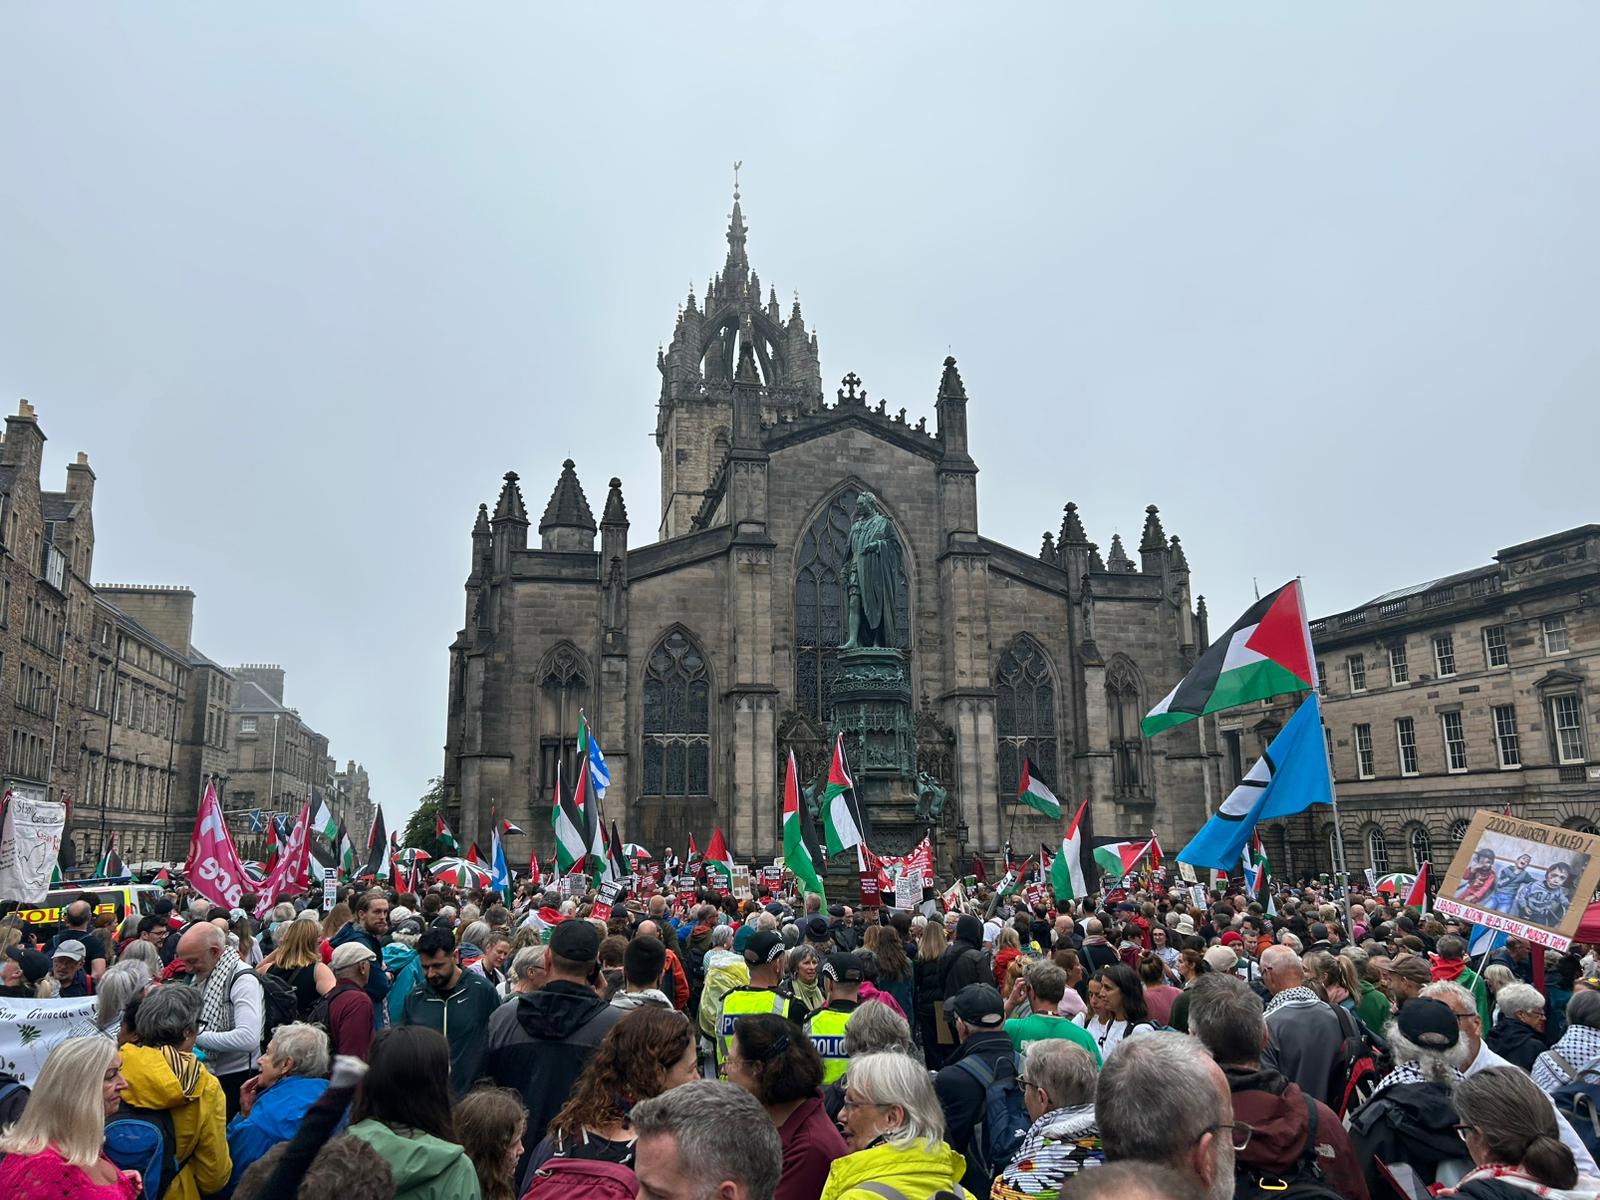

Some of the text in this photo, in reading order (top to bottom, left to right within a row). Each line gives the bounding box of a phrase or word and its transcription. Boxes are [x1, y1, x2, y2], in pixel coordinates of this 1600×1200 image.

[1552, 832, 1584, 849] KILLED
[9, 903, 114, 923] POLE
[1463, 907, 1483, 922] ACTION
[1502, 919, 1524, 935] ISRAEL
[1524, 927, 1549, 944] MURDER
[1549, 935, 1568, 950] THEM
[27, 1007, 74, 1020] Genocide
[79, 1009, 90, 1017] in
[811, 1038, 848, 1056] OLIC
